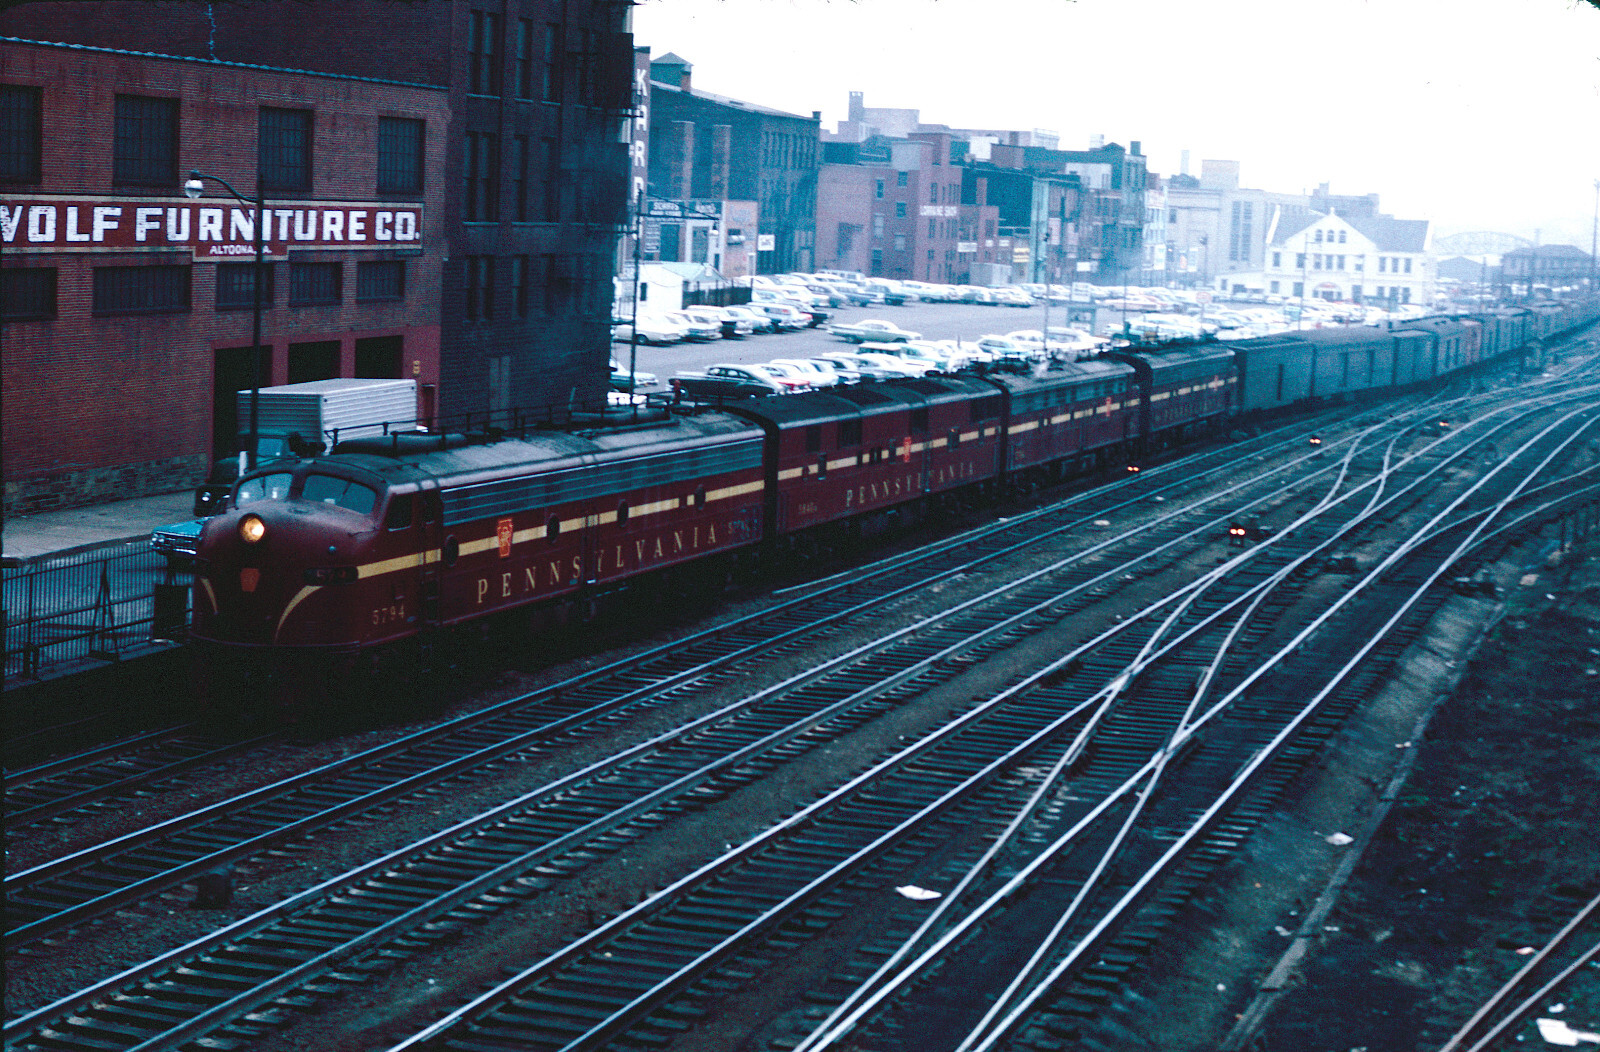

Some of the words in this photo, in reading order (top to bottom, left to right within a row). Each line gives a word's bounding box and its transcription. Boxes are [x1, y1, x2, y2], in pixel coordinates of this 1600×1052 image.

[136, 206, 367, 242] FURNITURE
[375, 210, 420, 241] CO.
[477, 523, 718, 604] PENNSYLVANIA
[372, 602, 405, 625] 5794
